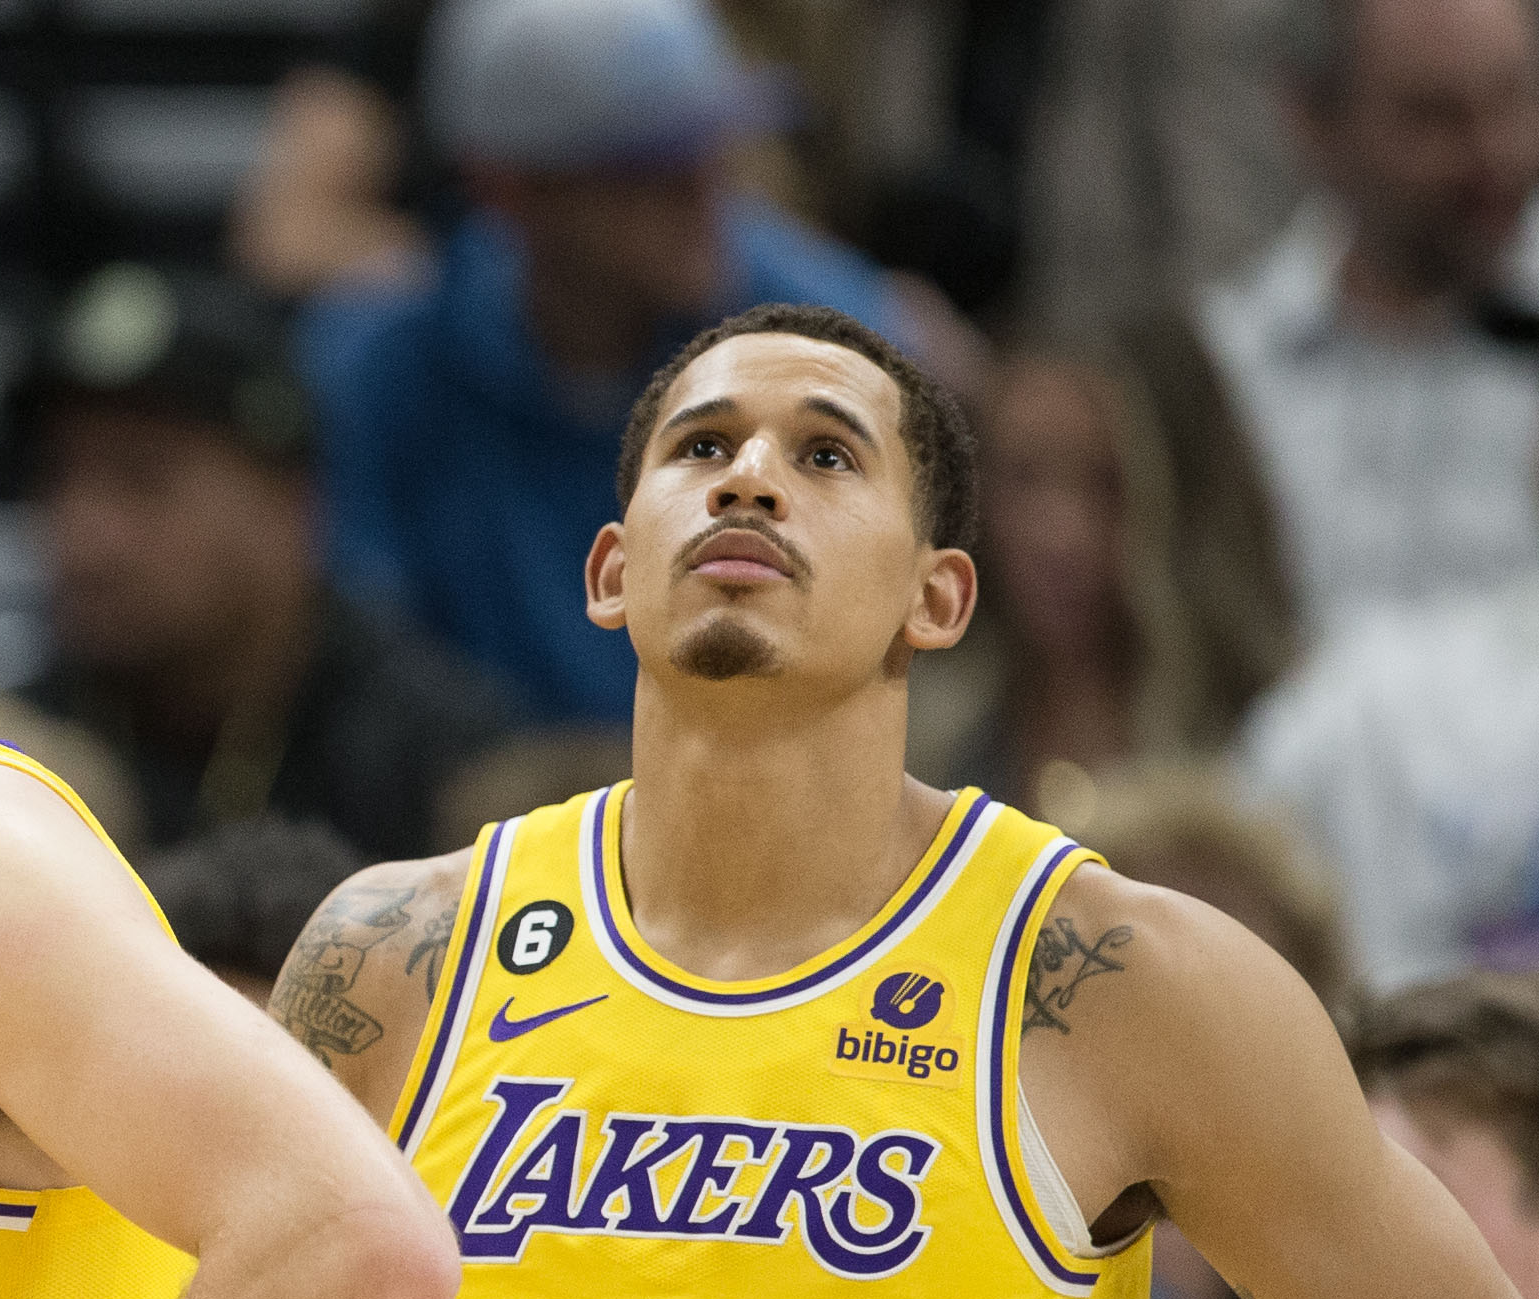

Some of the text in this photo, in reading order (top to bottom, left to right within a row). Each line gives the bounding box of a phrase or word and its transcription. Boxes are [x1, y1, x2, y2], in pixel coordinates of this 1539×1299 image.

[511, 909, 558, 966] 6
[836, 1027, 960, 1080] bibigo
[447, 1075, 942, 1282] LAKERS
